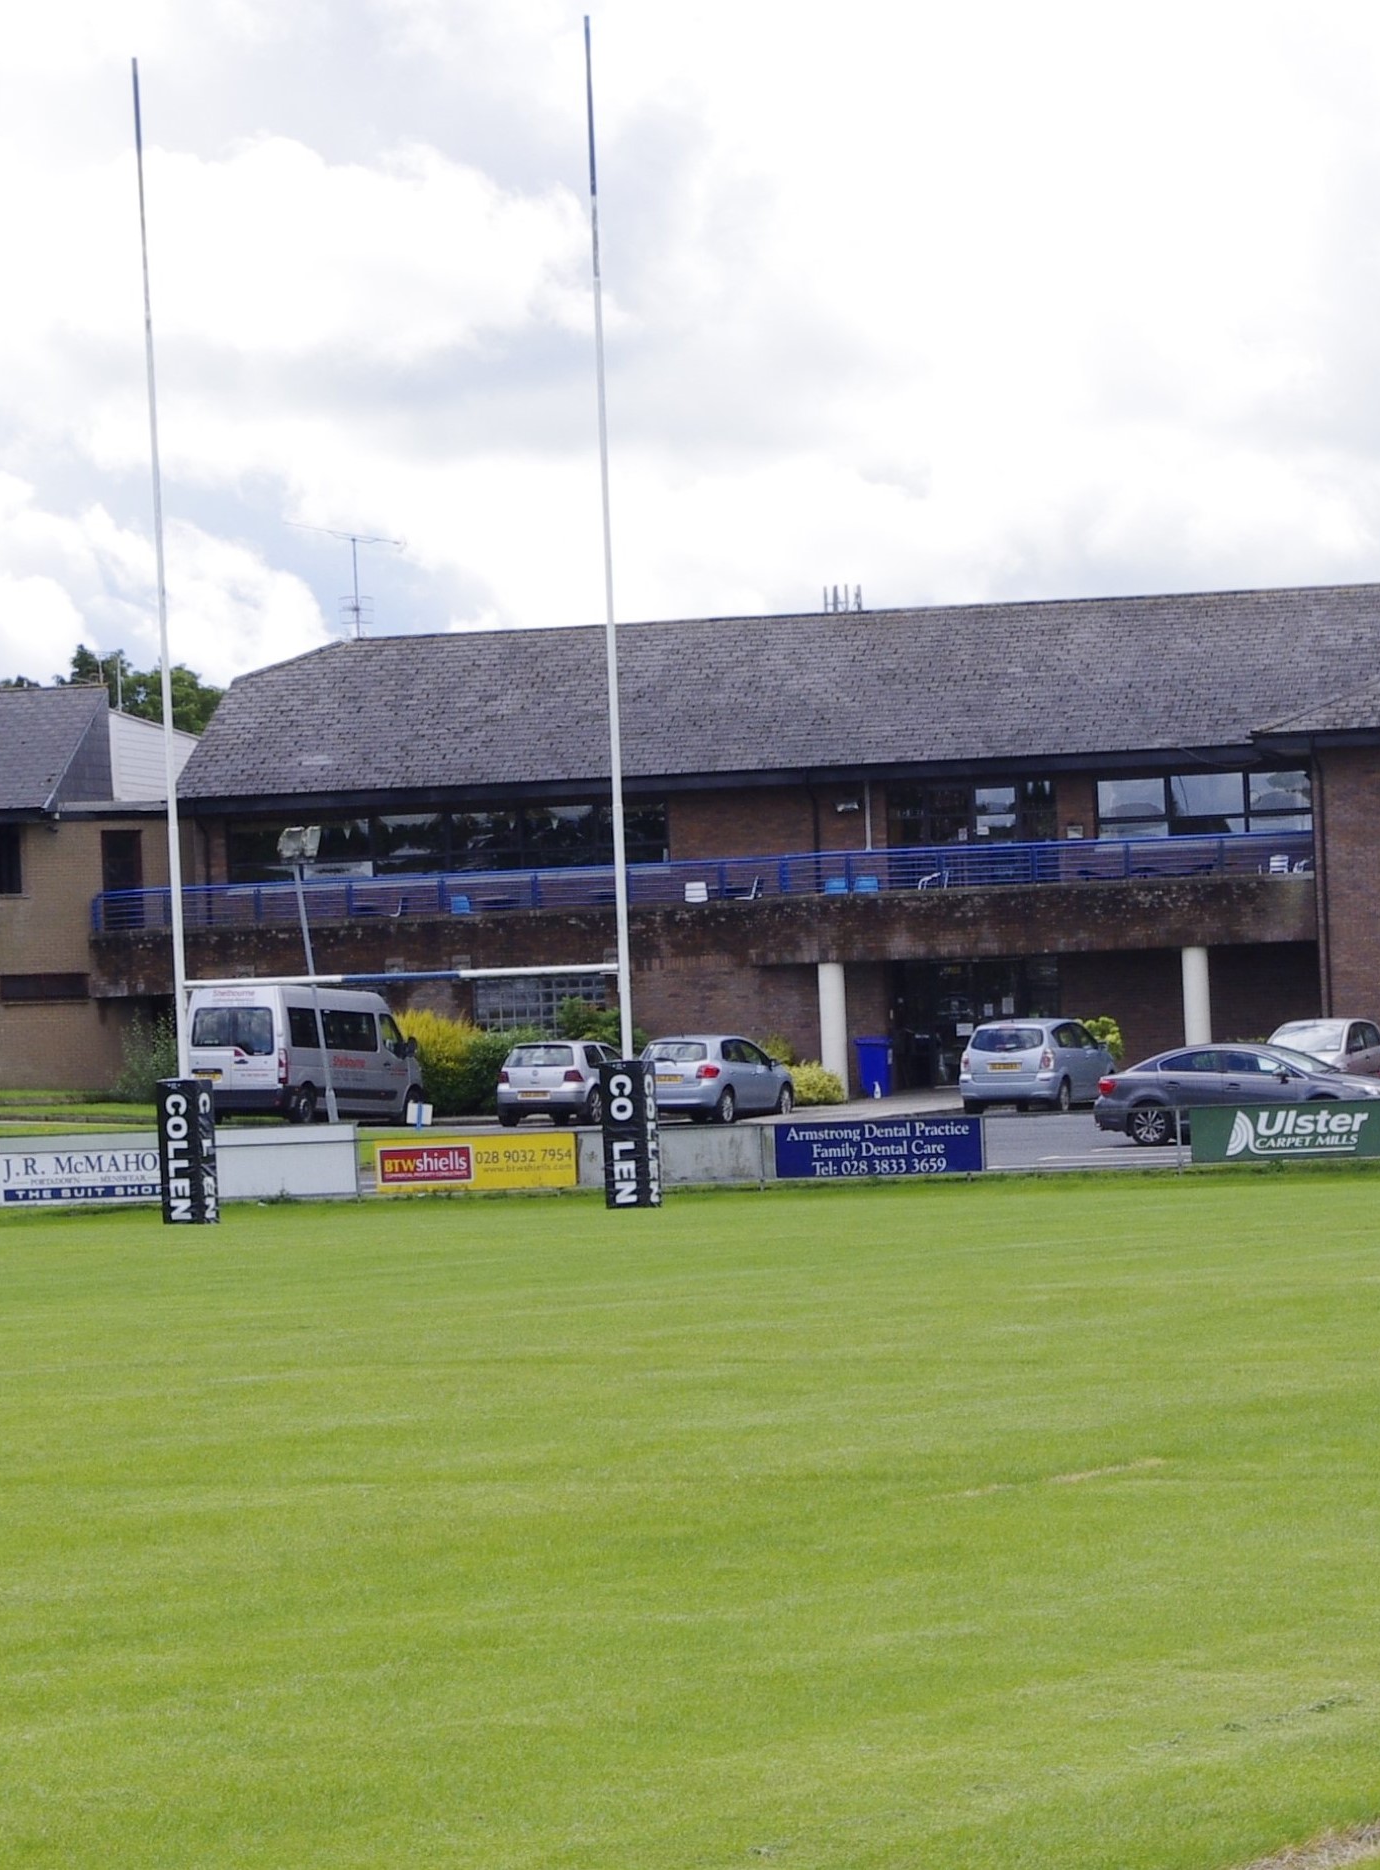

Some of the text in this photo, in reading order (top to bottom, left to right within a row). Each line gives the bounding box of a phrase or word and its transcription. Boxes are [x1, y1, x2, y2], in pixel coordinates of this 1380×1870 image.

[786, 1121, 970, 1143] Armstrong Dental Practice
[1256, 1110, 1369, 1136] Ulster
[609, 1074, 638, 1204] COLEN
[812, 1139, 946, 1160] Family Dental Care
[1255, 1134, 1359, 1149] CARPET MILLS
[165, 1094, 193, 1220] COLLEN
[384, 1151, 468, 1173] BTWshiells
[475, 1149, 572, 1164] 028 9032 7954
[812, 1157, 947, 1176] Tel: 028 3833 3659
[3, 1152, 162, 1183] J.R. McMAHO
[30, 1174, 147, 1186] PORTADOWN MENSWEAR
[15, 1190, 53, 1200] THE
[61, 1187, 106, 1198] SUIT
